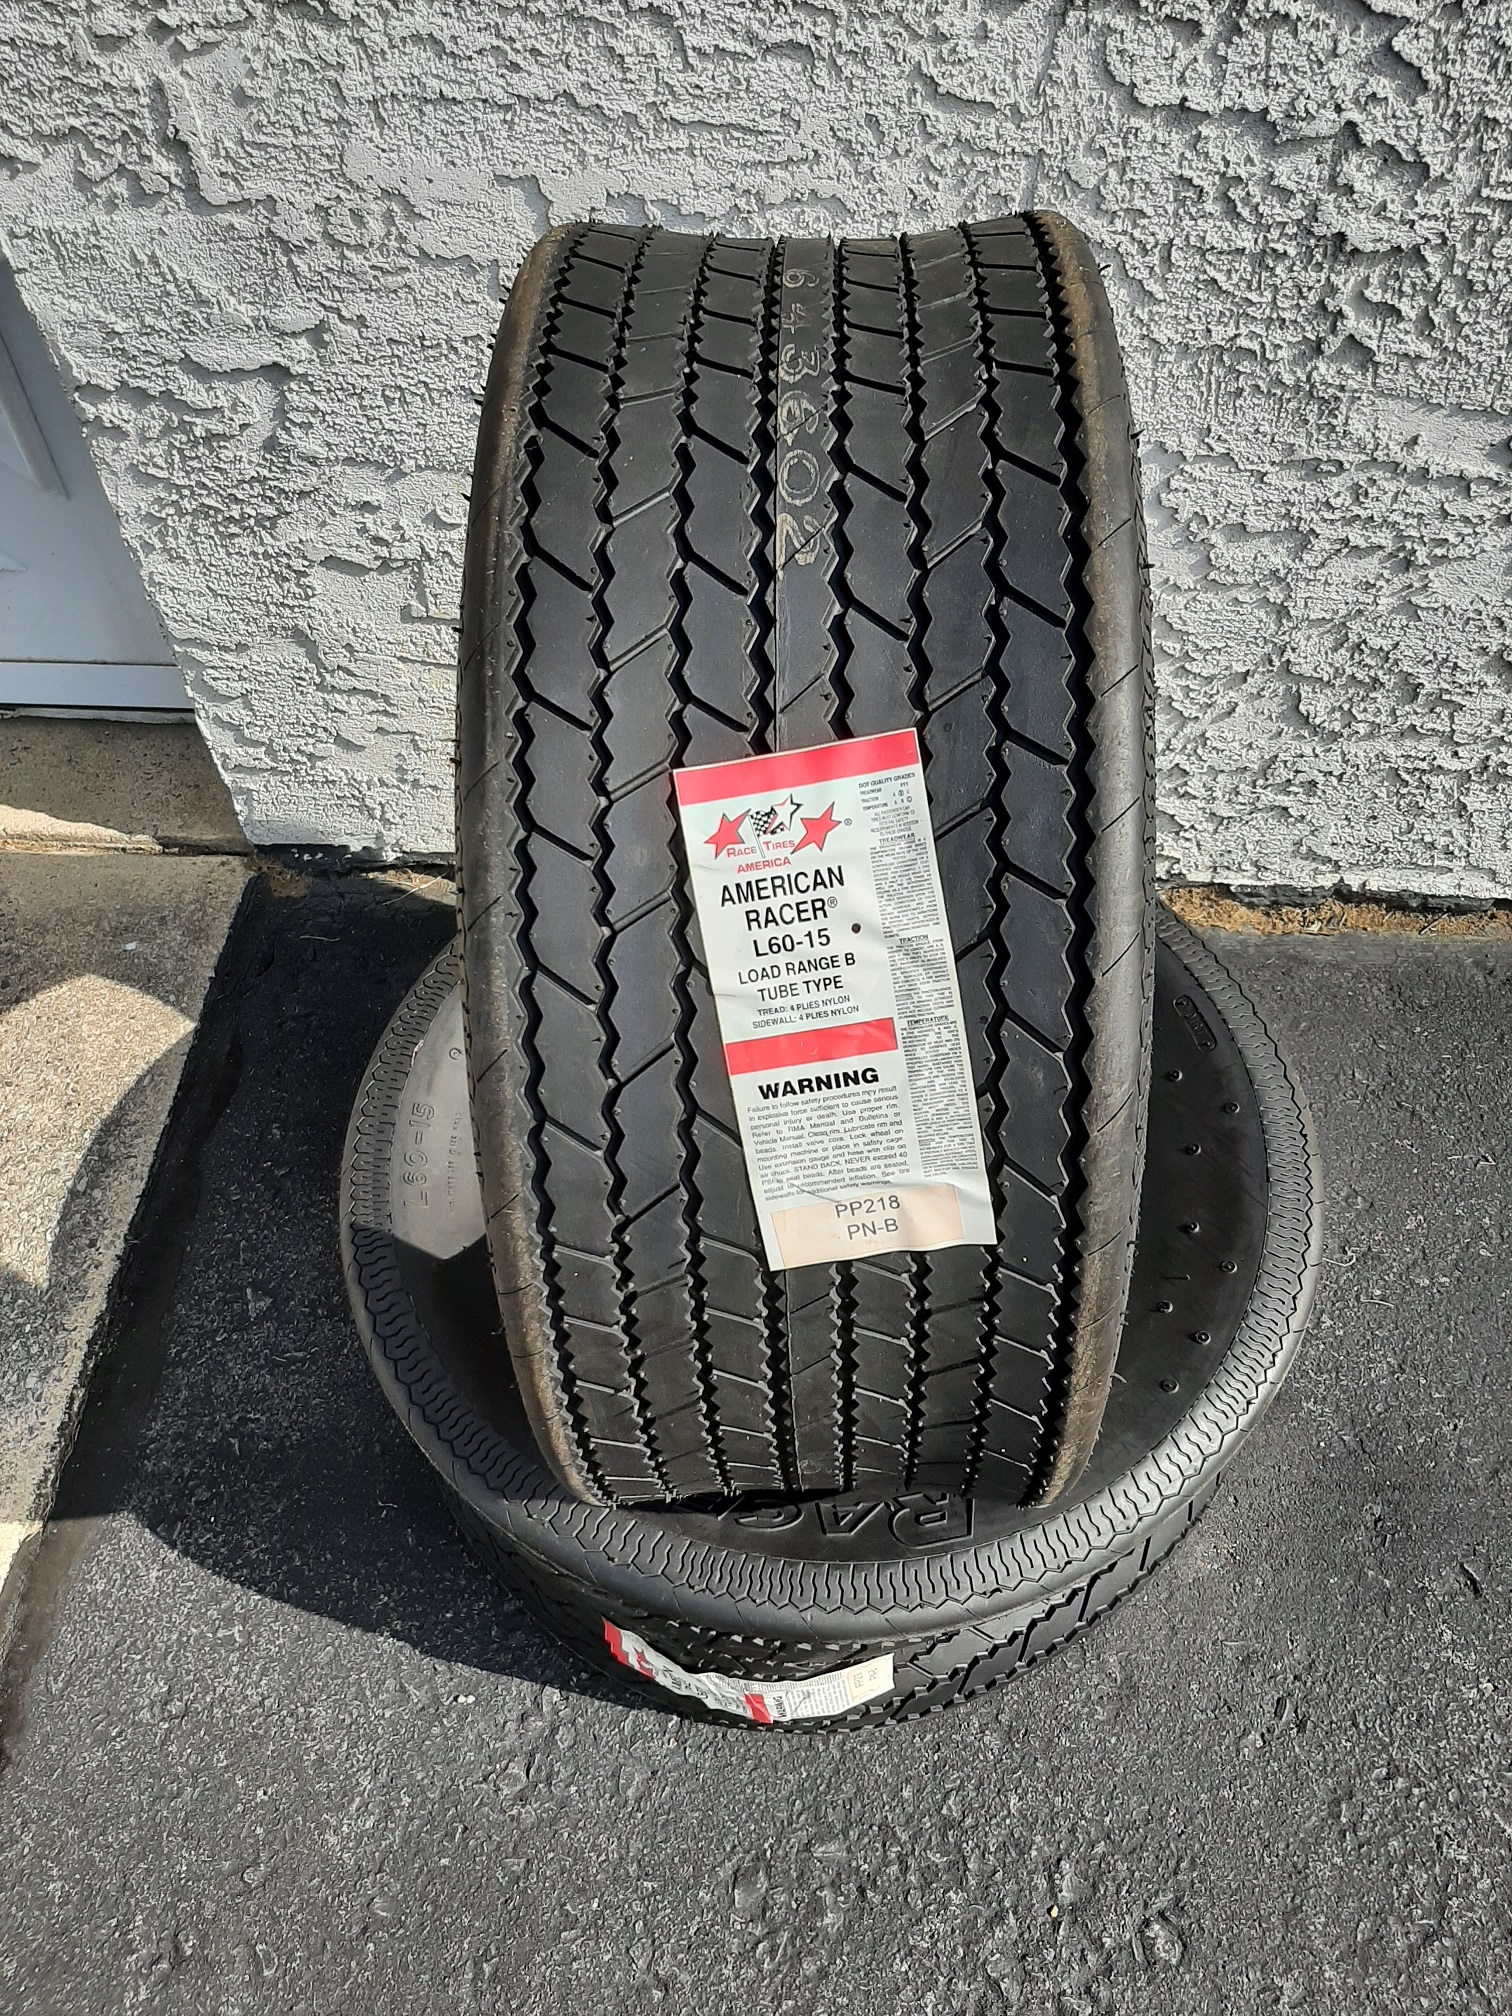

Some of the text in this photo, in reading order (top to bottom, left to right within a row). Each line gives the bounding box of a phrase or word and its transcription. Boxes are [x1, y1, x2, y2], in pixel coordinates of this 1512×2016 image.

[737, 856, 792, 874] AMERICA
[721, 865, 845, 907] AMERICAN
[753, 928, 831, 958] L60-15
[738, 952, 856, 985] LOAD RANGE B
[757, 975, 844, 1002] TUBE TYPE
[752, 1015, 797, 1029] SIDEWALL:
[805, 1010, 829, 1020] PLIES
[830, 1005, 860, 1017] NYLON
[757, 994, 850, 1016] TREAD: 4 PLIES NYLON
[758, 1068, 880, 1100] WARNING
[747, 1104, 770, 1113] Failure
[800, 1097, 821, 1106] safety
[822, 1091, 860, 1102] procedures
[878, 1085, 896, 1093] result
[757, 1110, 788, 1120] explosive
[790, 1107, 807, 1115] force
[809, 1102, 839, 1112] sufficient
[873, 1093, 898, 1102] serious
[750, 1121, 780, 1131] personal
[783, 1117, 802, 1125] injury
[859, 1105, 882, 1113] proper
[756, 1153, 787, 1163] mounting
[790, 1148, 818, 1156] machine
[793, 1163, 818, 1172] STAND
[844, 1156, 870, 1164] NEVER
[846, 1165, 867, 1173] beads
[763, 1185, 783, 1194] adjust
[806, 1185, 837, 1193] dditional
[835, 1195, 900, 1219] PP218
[847, 1218, 899, 1240] PN-B
